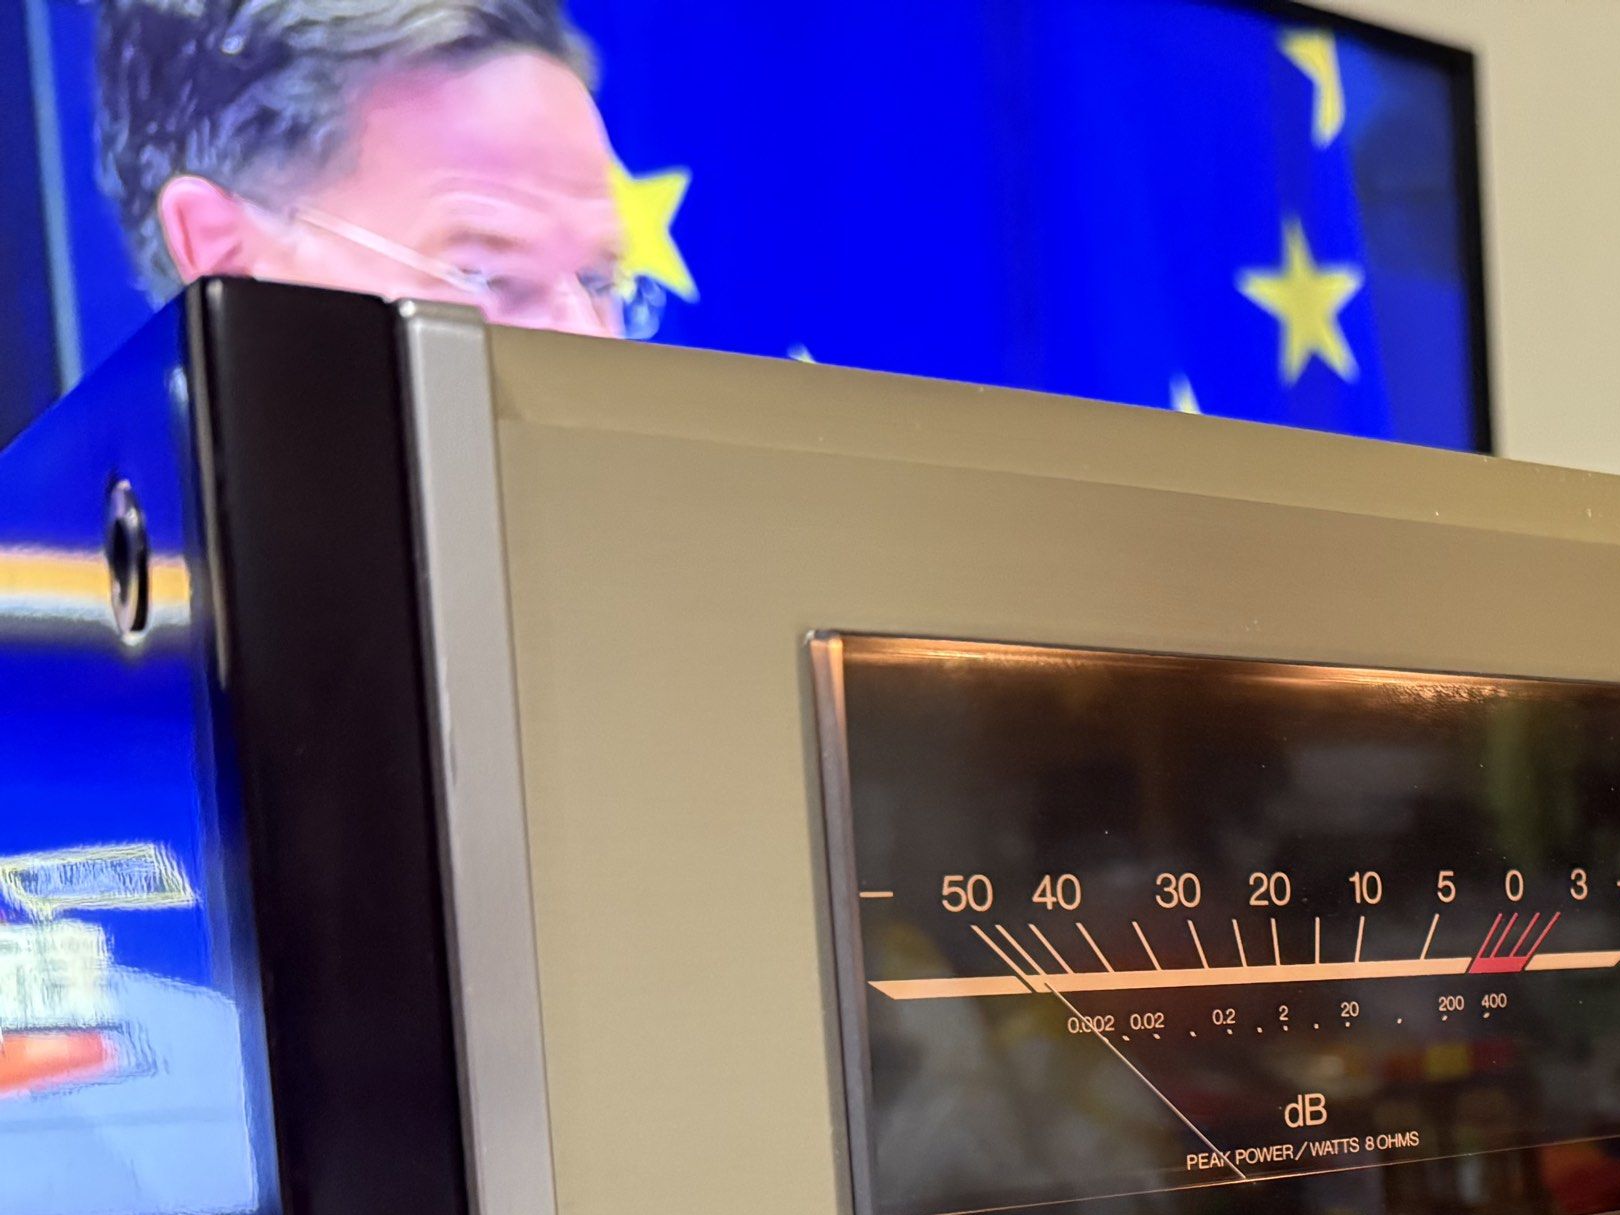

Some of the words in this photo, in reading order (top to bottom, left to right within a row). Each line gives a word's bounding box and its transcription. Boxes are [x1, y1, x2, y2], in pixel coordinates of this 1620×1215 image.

[941, 873, 994, 912] 50
[1032, 873, 1082, 911] 40
[1155, 872, 1201, 909] 30
[1248, 871, 1292, 906] 20
[1348, 870, 1383, 905] 10
[1436, 870, 1456, 903] 5
[1504, 869, 1524, 902] 0
[1570, 868, 1588, 901] 3
[1067, 1015, 1115, 1034] 0.002
[1130, 1012, 1165, 1030] 0.02
[1212, 1008, 1236, 1026] 0.2
[1279, 1005, 1289, 1021] 2
[1340, 1001, 1359, 1018] 20
[1438, 996, 1465, 1012] 200
[1481, 993, 1507, 1009] 400
[1284, 1093, 1328, 1129] dB
[1186, 1151, 1231, 1170] PEAK
